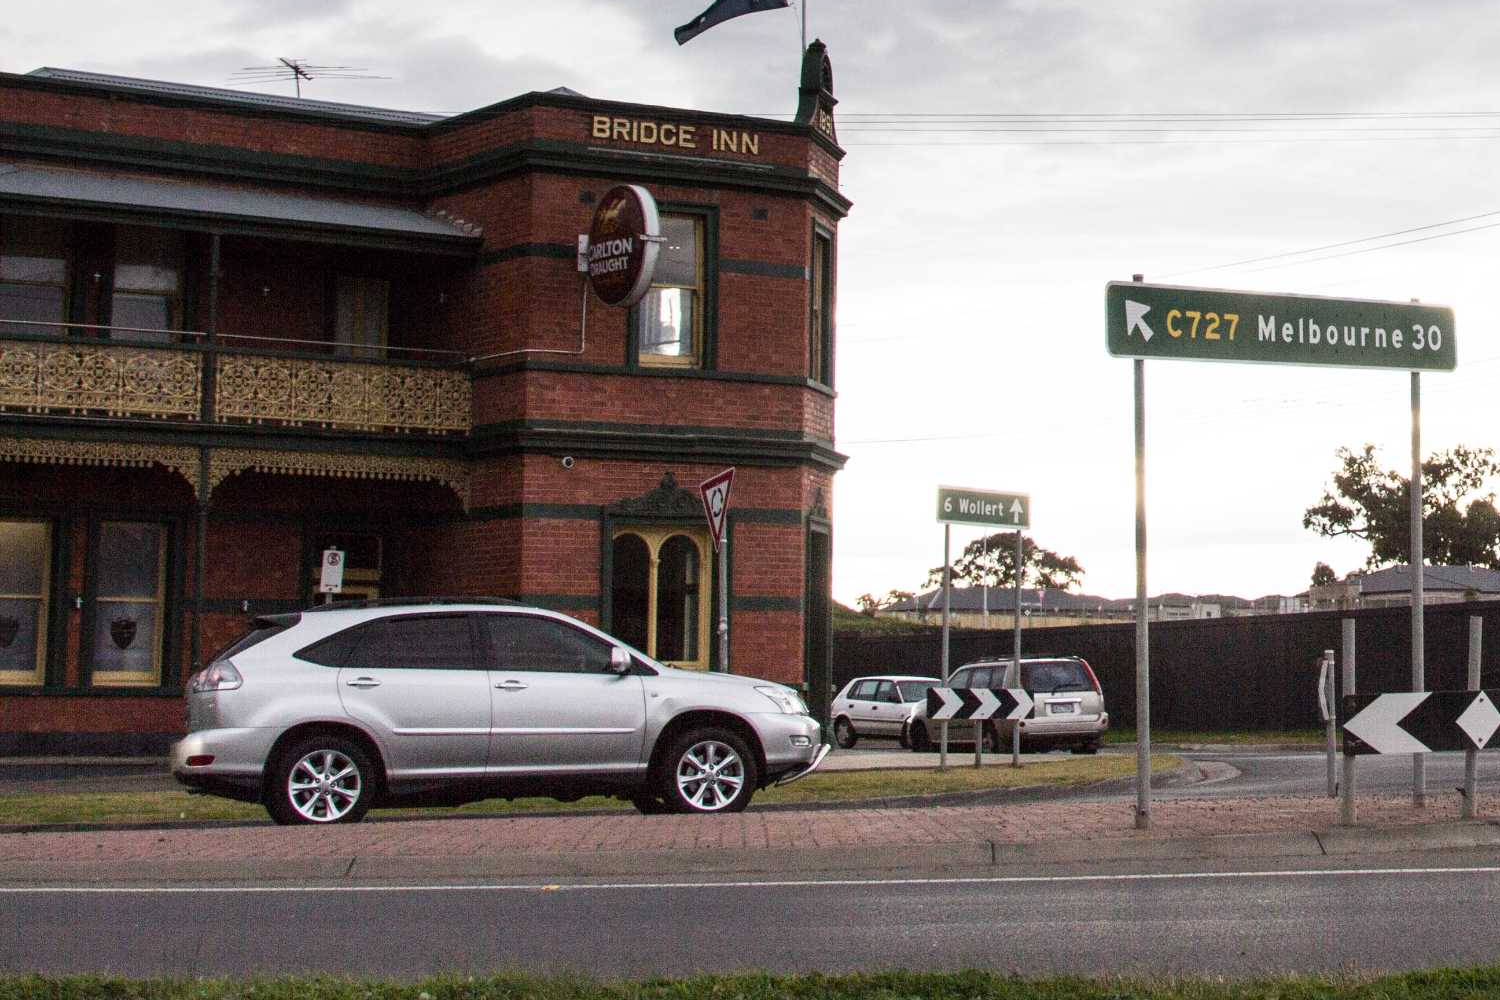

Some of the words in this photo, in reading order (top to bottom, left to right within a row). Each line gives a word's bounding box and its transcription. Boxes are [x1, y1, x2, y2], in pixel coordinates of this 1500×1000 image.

[712, 128, 759, 155] INN
[1166, 309, 1240, 341] C727
[1257, 314, 1404, 350] Melbourne
[1412, 324, 1443, 351] 30
[944, 497, 953, 513] 6
[959, 498, 1004, 516] Wollert
